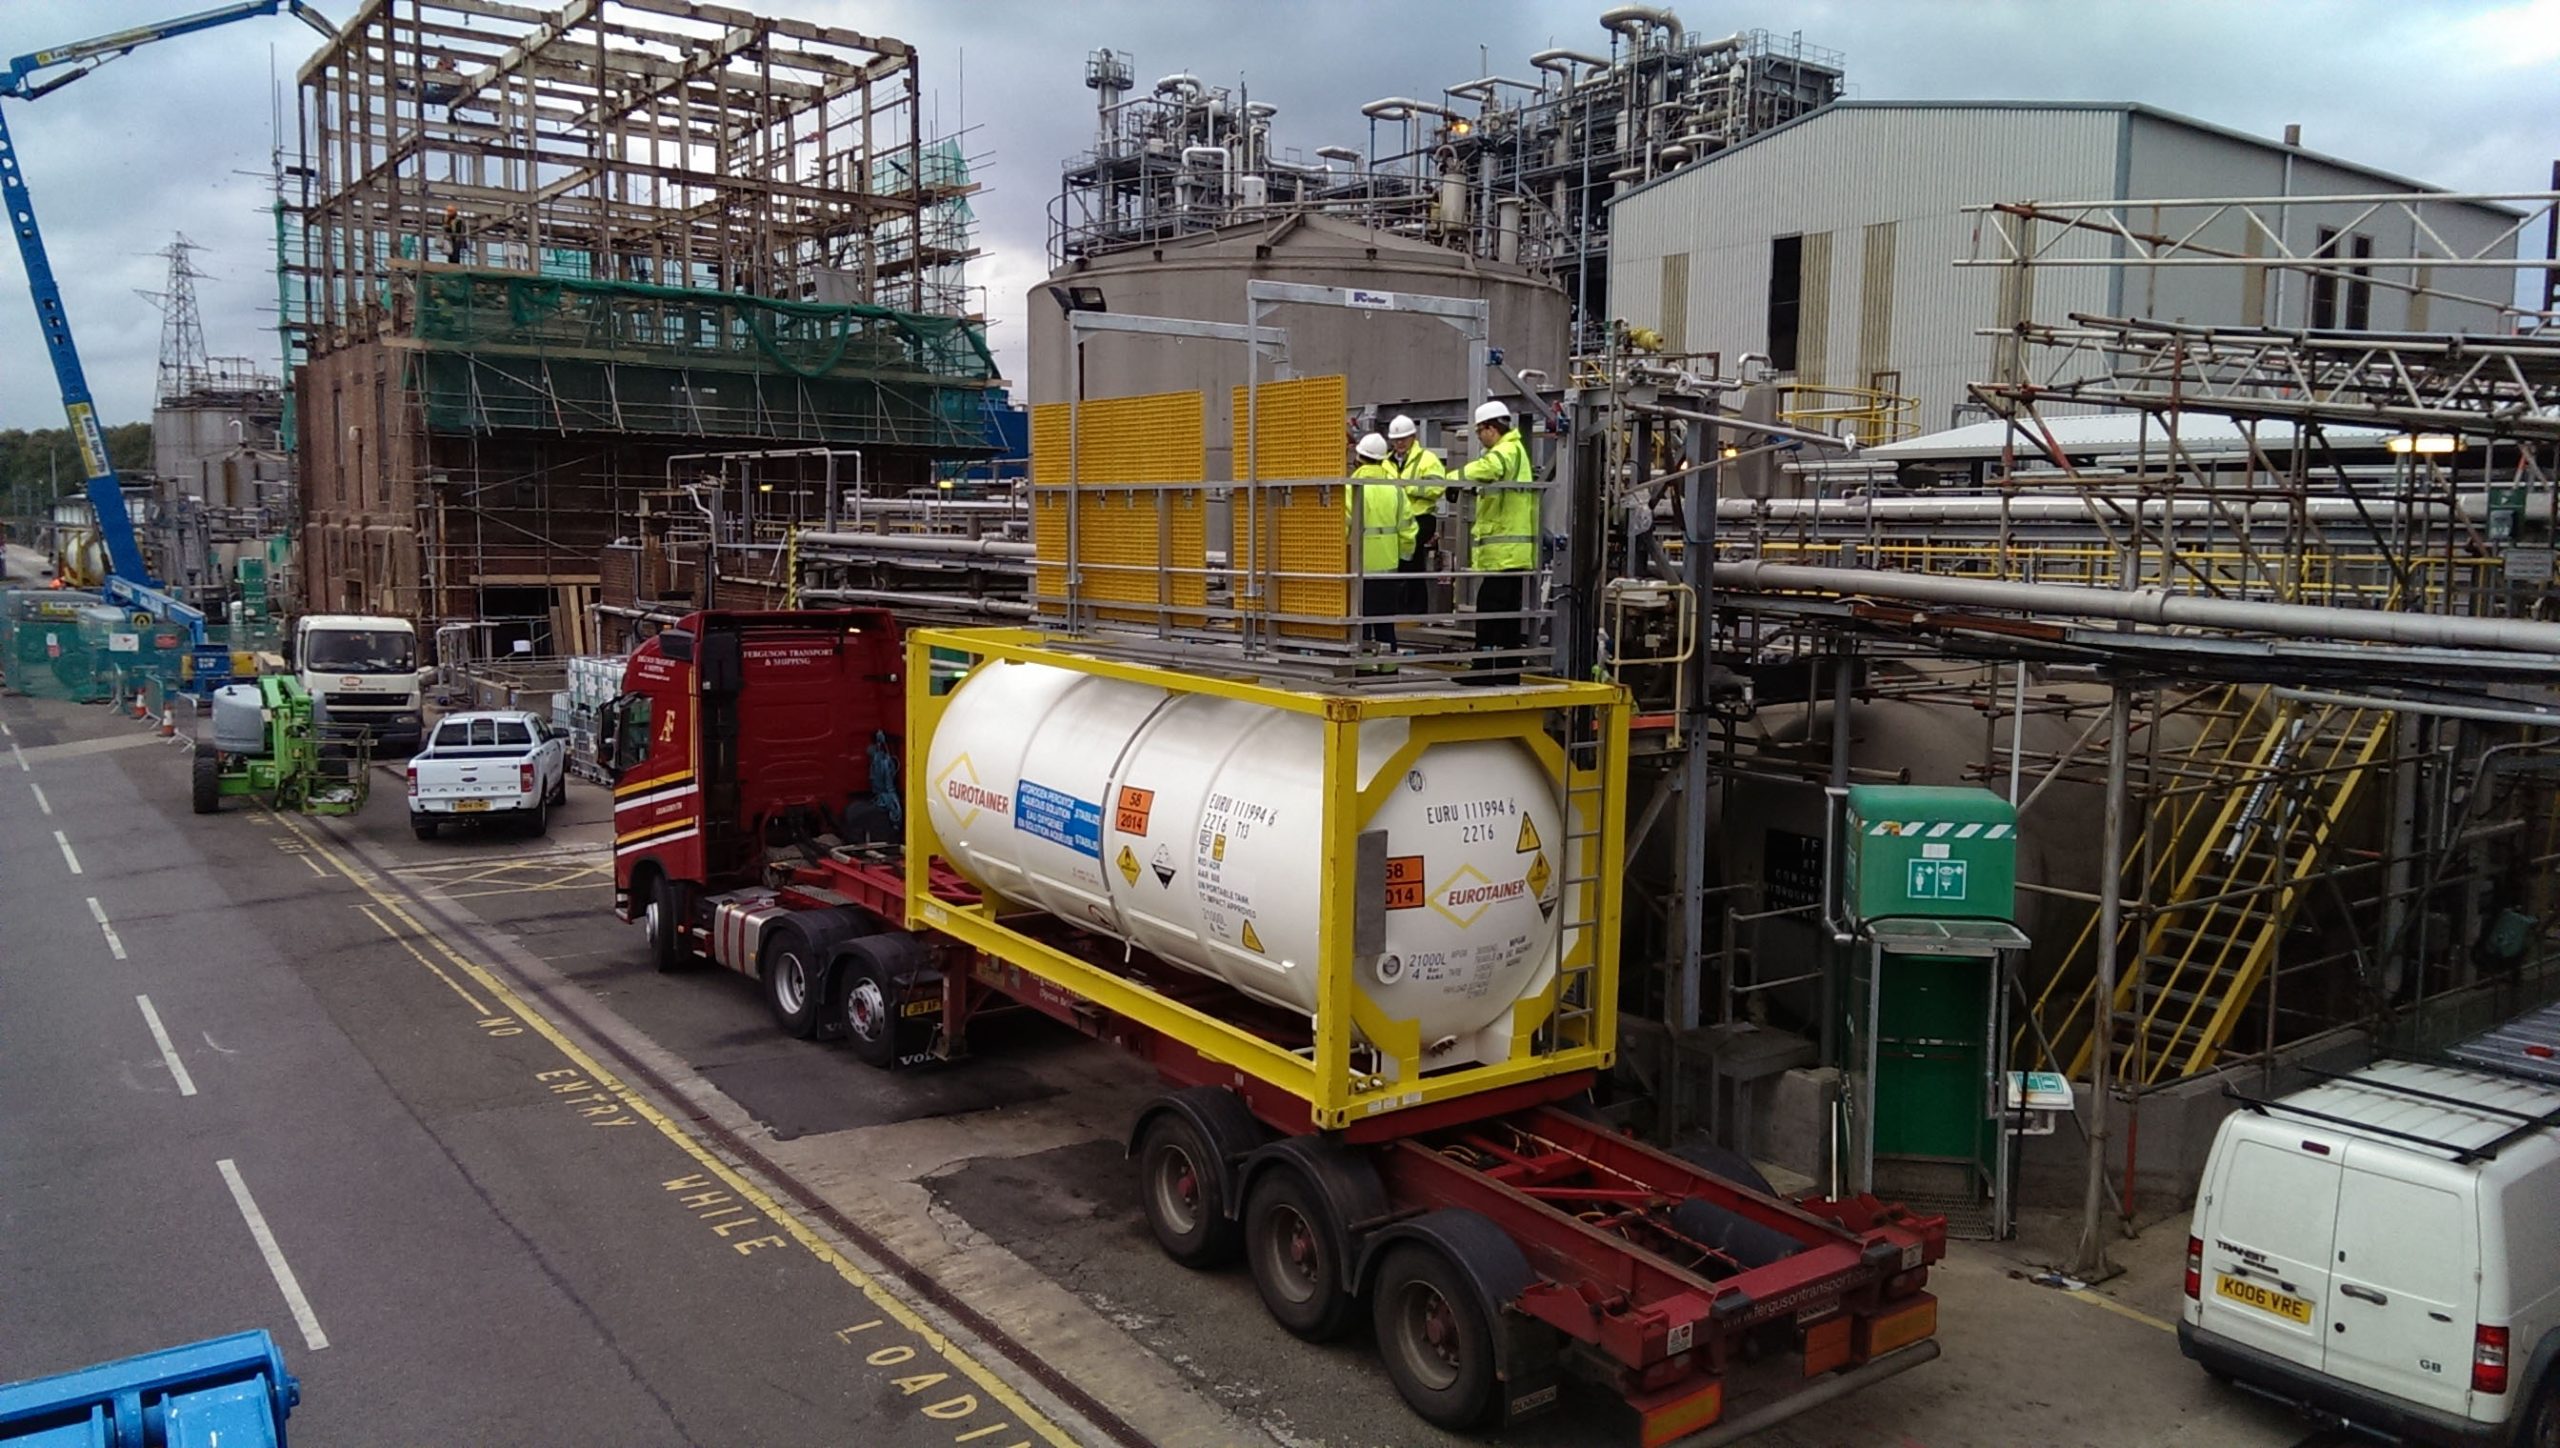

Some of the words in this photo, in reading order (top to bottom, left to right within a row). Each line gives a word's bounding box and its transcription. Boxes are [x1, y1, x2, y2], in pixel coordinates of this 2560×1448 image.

[764, 658, 772, 667] &
[789, 648, 834, 658] TRANSPORT
[949, 779, 1009, 816] EUROTAINER
[1128, 792, 1143, 807] 58
[1208, 793, 1234, 814] EURU
[1232, 800, 1266, 823] 111994
[1266, 809, 1279, 827] 6
[1426, 804, 1460, 825] EURU
[1464, 799, 1505, 820] 111994
[1508, 798, 1517, 816] 6
[1120, 813, 1143, 831] 2014
[1203, 812, 1228, 833] 22T6
[1235, 821, 1251, 840] T13
[1462, 823, 1495, 844] 22T6
[1385, 887, 1415, 905] 014
[1448, 879, 1526, 907] EUROTAINER
[1408, 952, 1447, 968] 21000L
[1411, 967, 1421, 981] 4
[476, 1016, 524, 1037] NO
[899, 1052, 937, 1066] VOL
[535, 1068, 638, 1126] ENTRY
[661, 1173, 788, 1256] WHILE
[2215, 1238, 2268, 1263] TRANSIT
[2270, 1292, 2303, 1318] VRE
[2419, 1359, 2442, 1374] GB
